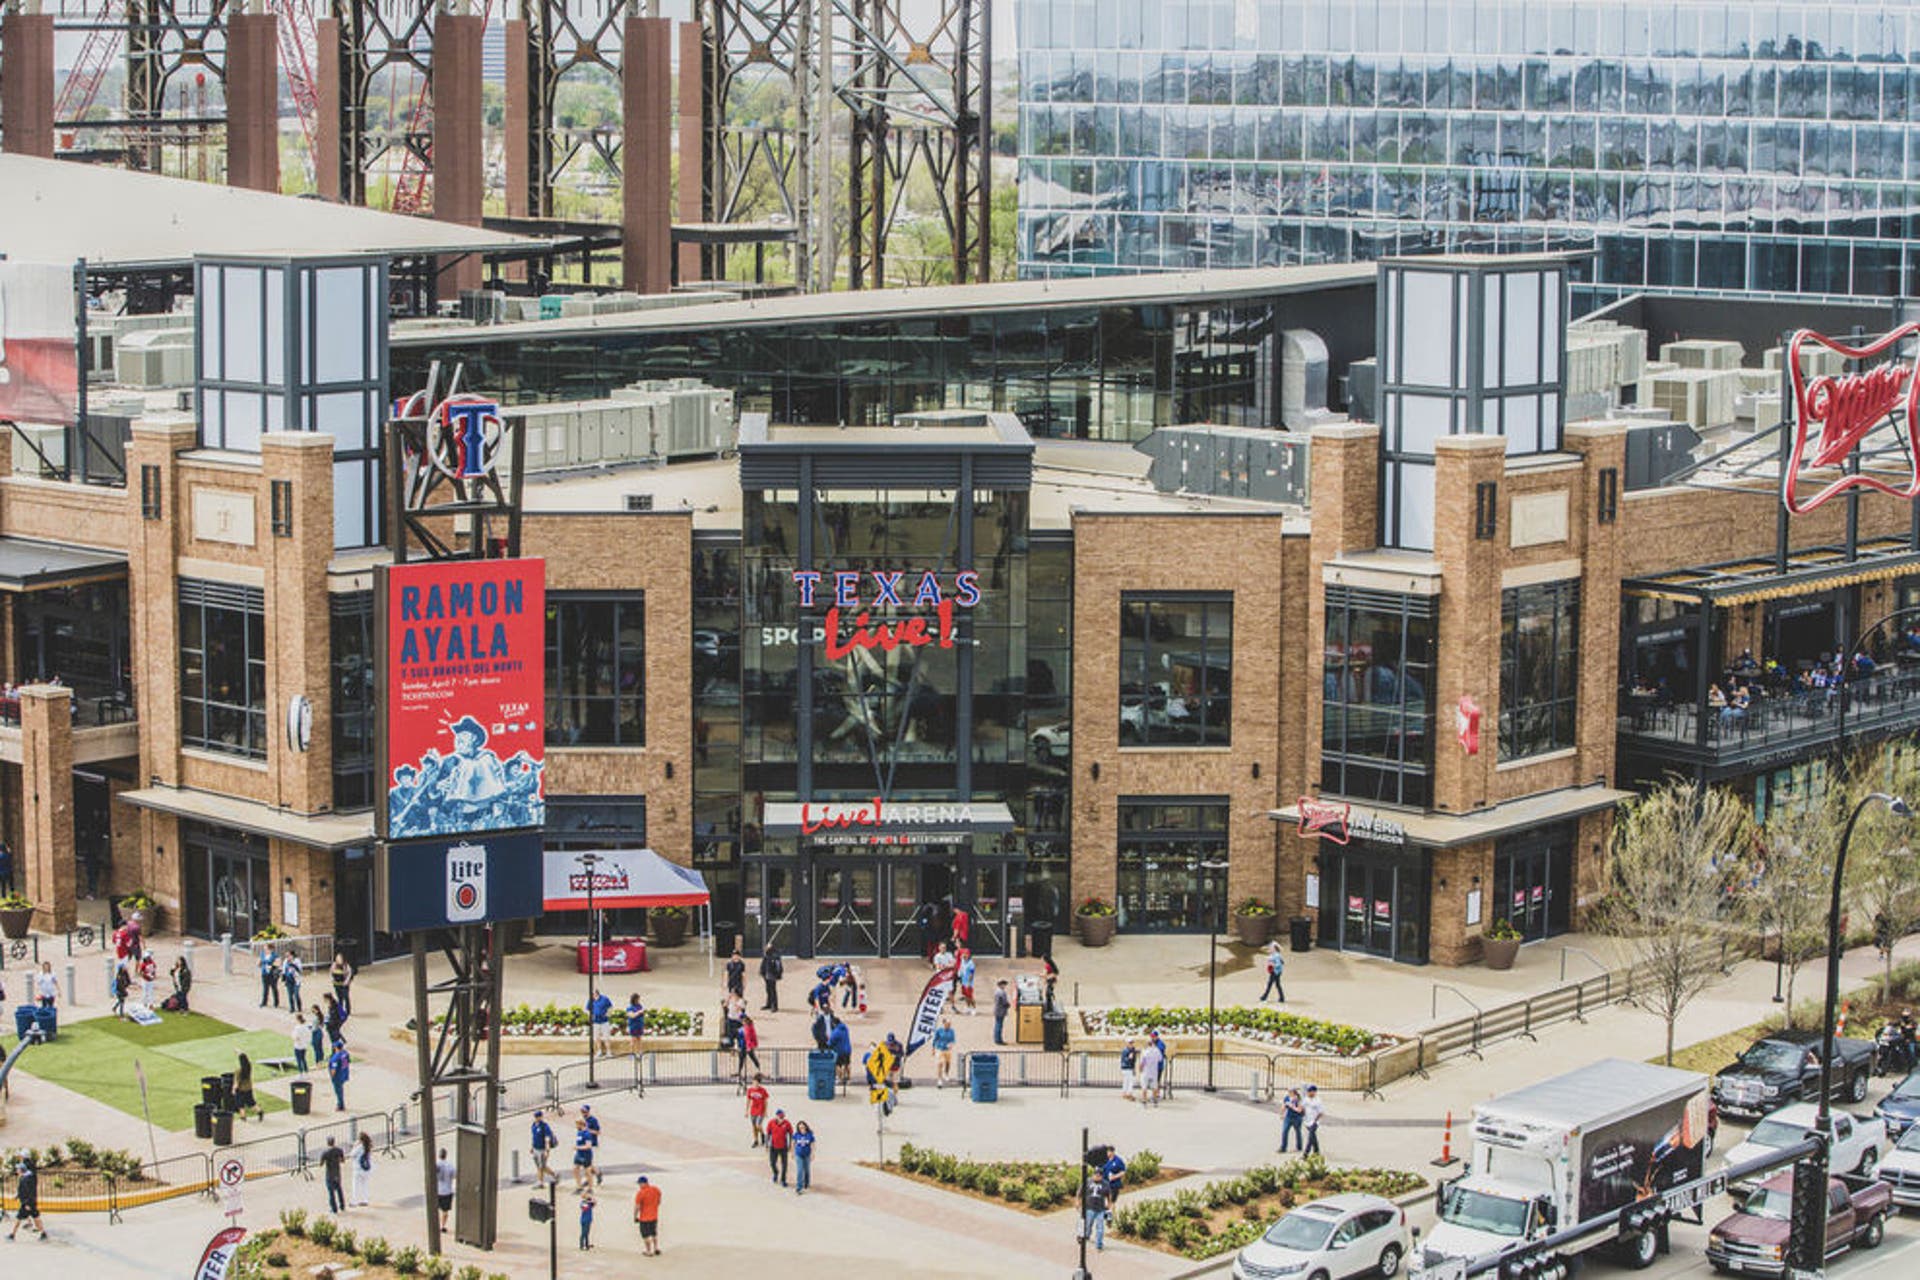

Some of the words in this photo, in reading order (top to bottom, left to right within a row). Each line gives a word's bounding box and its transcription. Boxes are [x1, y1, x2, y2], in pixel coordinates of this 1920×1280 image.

[402, 579, 523, 621] RAMON
[793, 571, 981, 607] TEXAS
[401, 623, 508, 663] AYALA
[825, 599, 953, 660] Live!
[802, 797, 882, 835] Live!
[886, 804, 975, 824] ARENA
[451, 861, 483, 883] Lite
[918, 988, 944, 1035] ENTER
